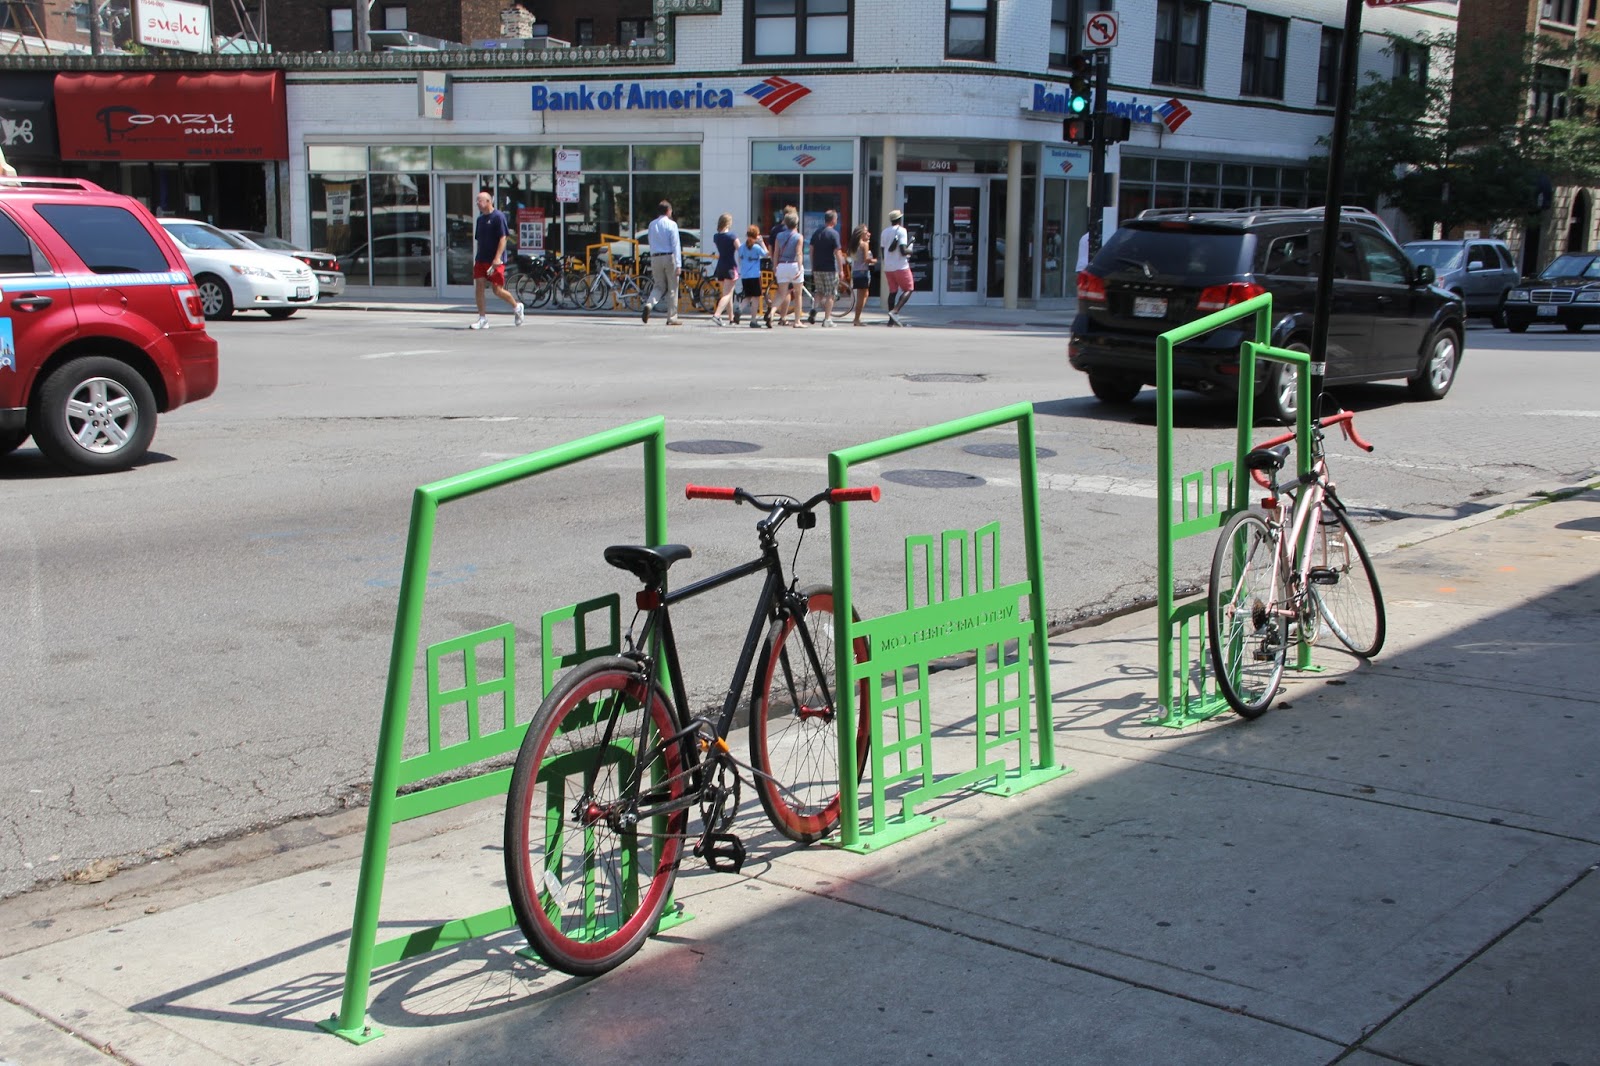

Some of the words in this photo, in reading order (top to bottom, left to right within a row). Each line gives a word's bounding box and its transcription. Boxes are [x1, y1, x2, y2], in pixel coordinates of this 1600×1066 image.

[148, 12, 200, 36] sushi
[532, 84, 595, 111] Bank
[597, 83, 624, 111] of
[626, 82, 733, 110] America
[96, 105, 234, 144] Ponzu
[183, 123, 235, 135] sushi
[931, 160, 951, 170] 2401
